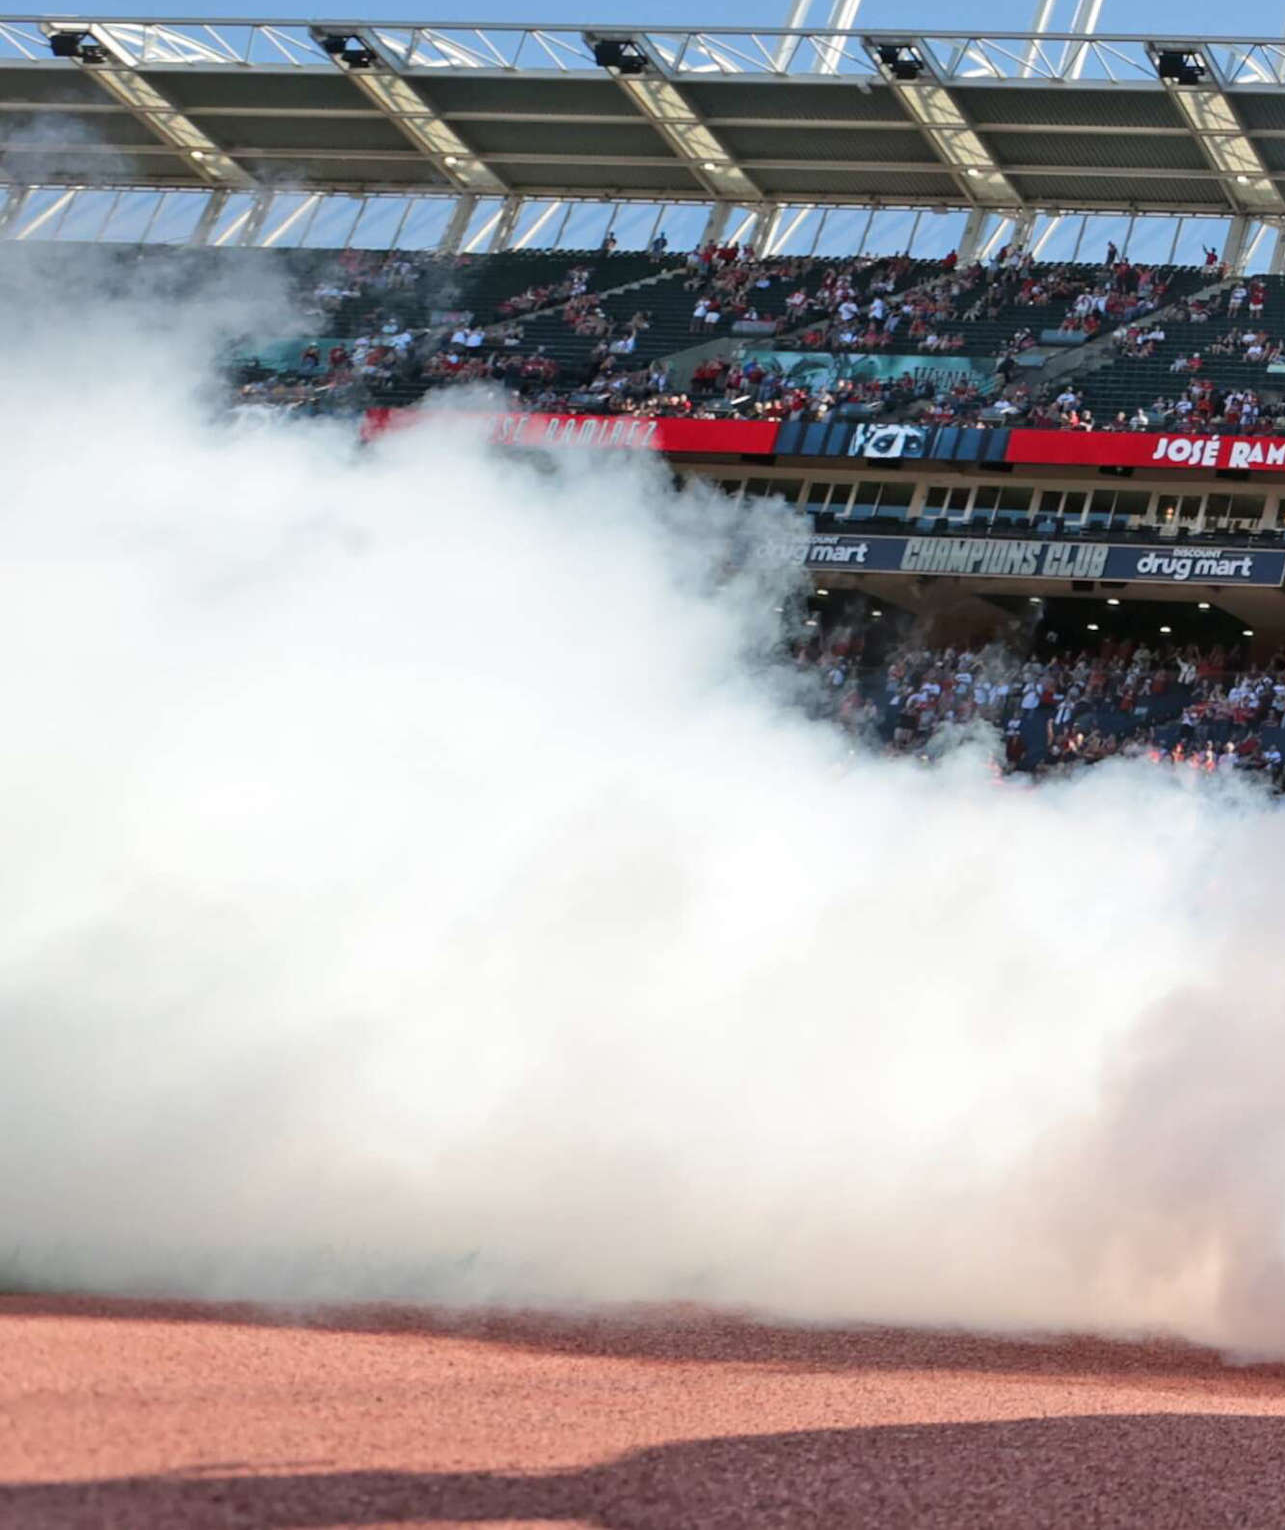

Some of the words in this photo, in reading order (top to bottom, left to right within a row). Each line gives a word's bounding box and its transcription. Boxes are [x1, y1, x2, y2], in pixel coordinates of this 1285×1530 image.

[1153, 434, 1221, 467] JOSÉ
[810, 543, 869, 562] mart
[901, 538, 1043, 575] CHAMPIONS
[1042, 542, 1109, 578] CLUB
[1136, 552, 1193, 580] drug
[1193, 556, 1253, 577] mart
